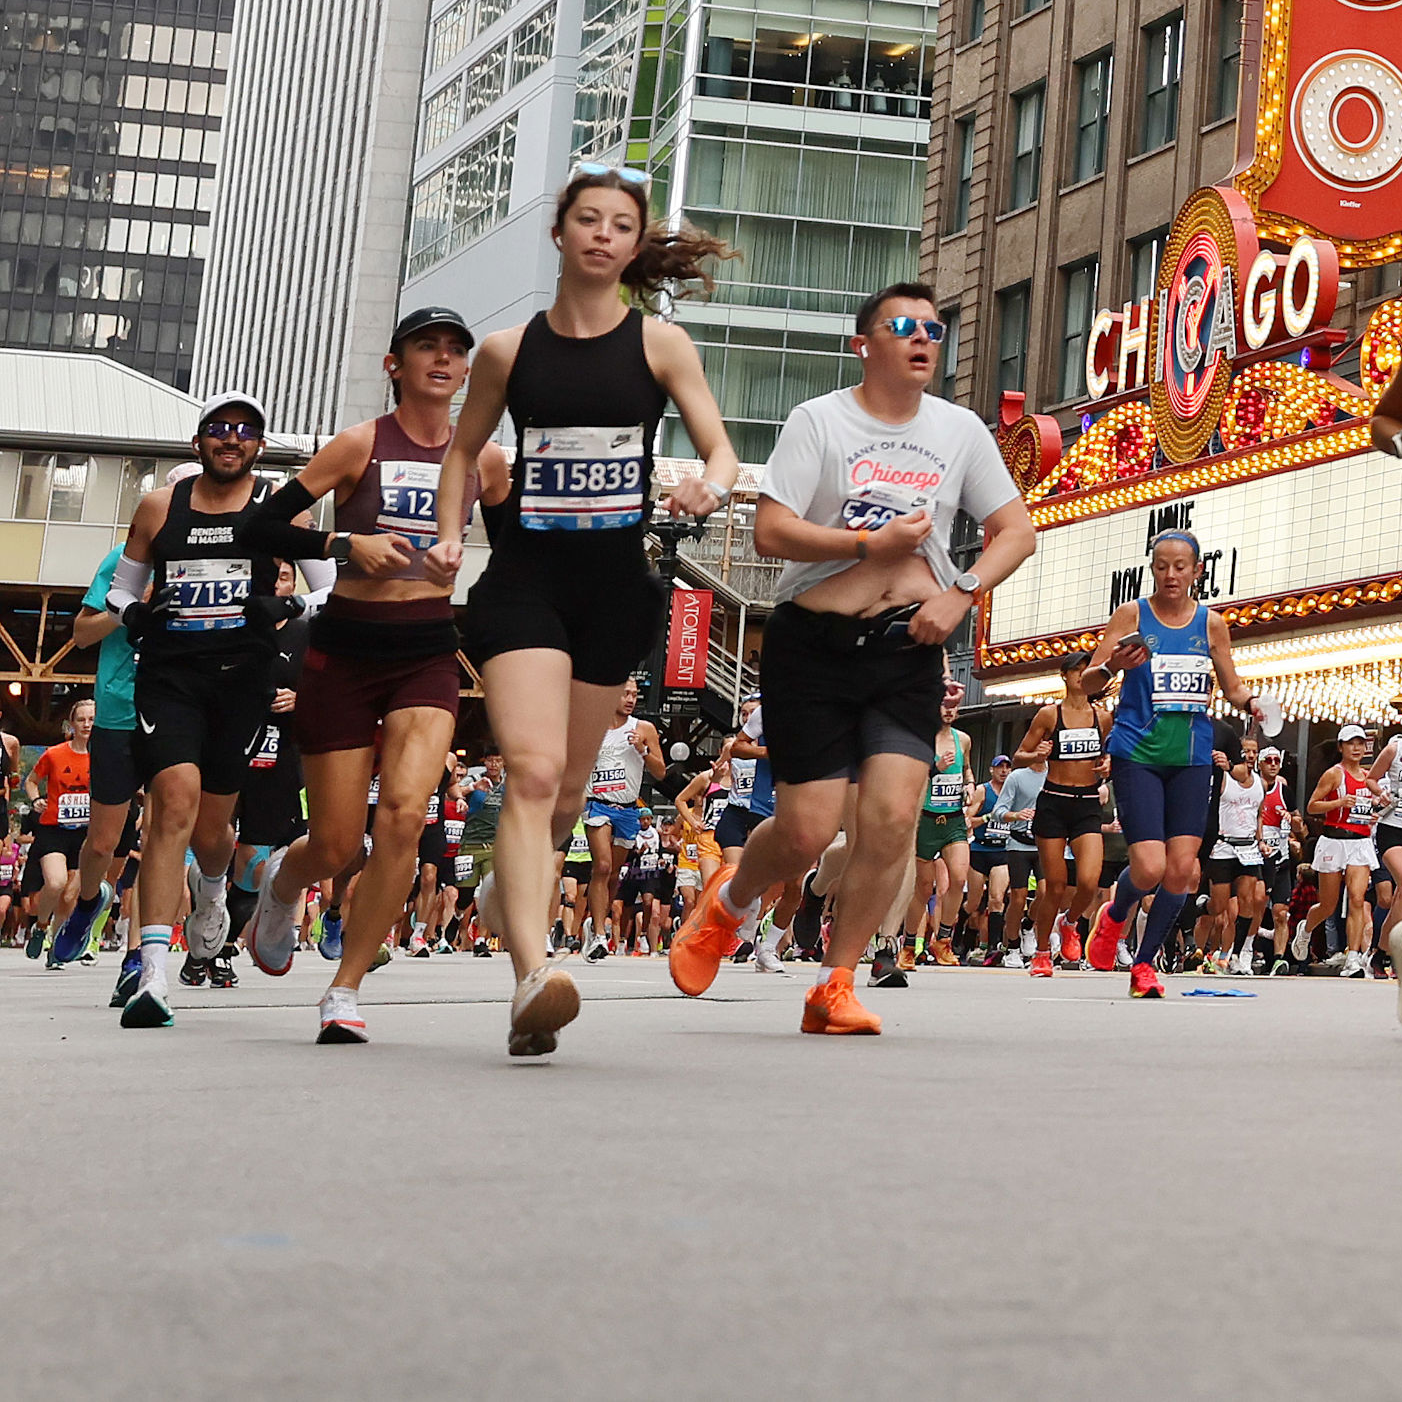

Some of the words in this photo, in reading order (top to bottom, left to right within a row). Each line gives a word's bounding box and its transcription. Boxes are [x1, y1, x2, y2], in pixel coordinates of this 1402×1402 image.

[1086, 234, 1320, 398] CHICAGO
[847, 444, 877, 465] BANK
[881, 441, 896, 450] OF
[900, 441, 946, 472] AMERICA
[525, 462, 543, 490] E
[553, 460, 640, 492] 15839
[851, 459, 942, 491] Chicago
[383, 489, 399, 512] E
[407, 490, 434, 516] 12
[843, 500, 861, 519] E
[187, 536, 197, 544] NI
[199, 535, 234, 544] MADRES
[190, 527, 233, 536] RENDIRSE
[168, 583, 182, 605] E
[190, 581, 250, 606] 7134
[677, 593, 700, 684] ATONEMENT
[1154, 673, 1166, 691] E
[1170, 673, 1207, 692] 8951
[1060, 742, 1067, 752] E
[1071, 740, 1100, 753] 15105
[599, 770, 625, 780] 21560
[738, 777, 746, 788] E
[932, 784, 938, 795] E
[61, 795, 89, 805] ASHLE
[59, 808, 66, 818] E
